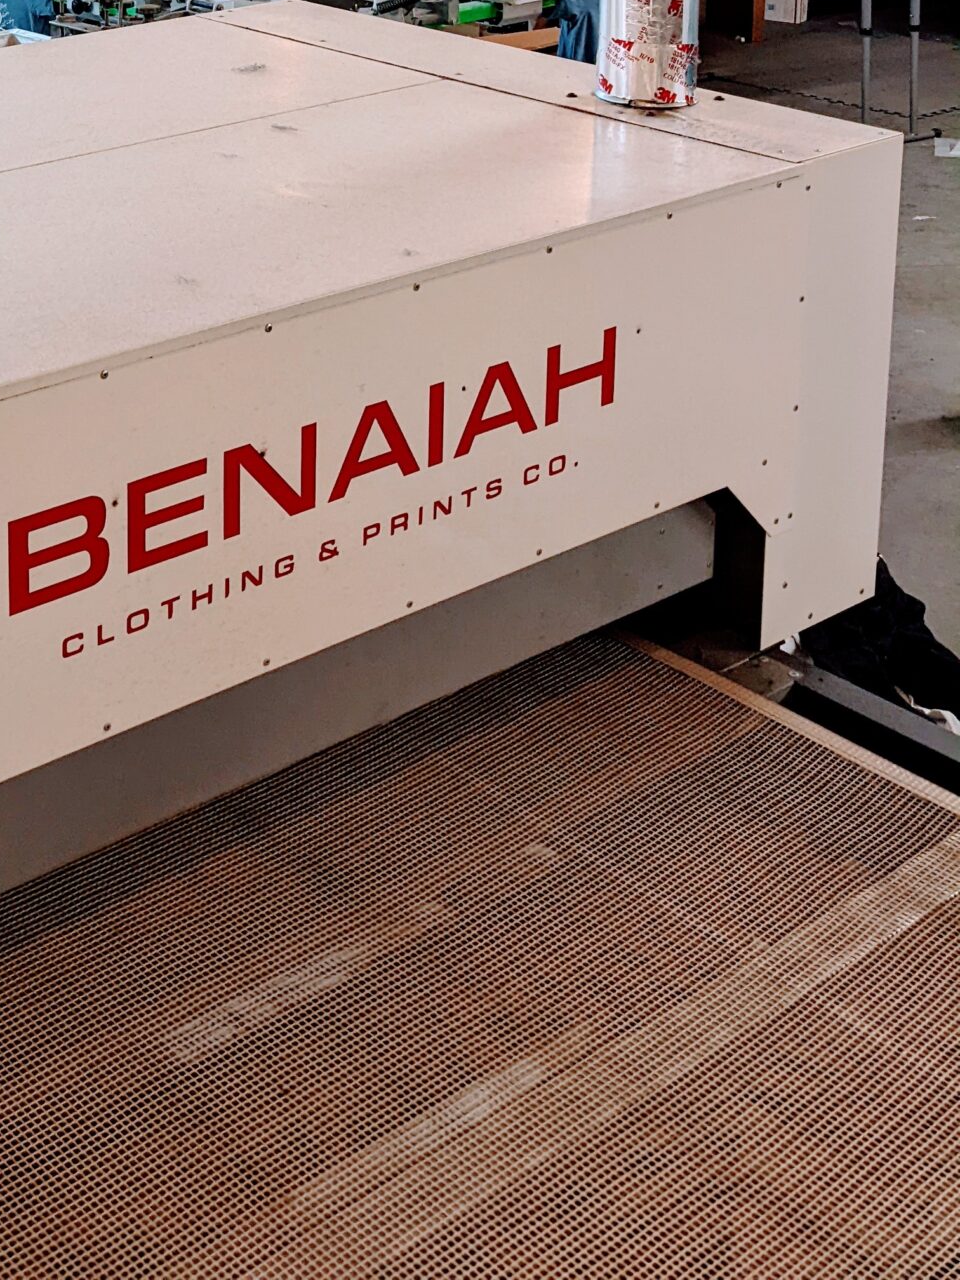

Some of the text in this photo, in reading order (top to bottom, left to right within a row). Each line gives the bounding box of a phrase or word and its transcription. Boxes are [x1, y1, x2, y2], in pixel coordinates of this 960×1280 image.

[654, 86, 678, 103] 3M
[7, 326, 617, 616] BENAIAH
[61, 455, 579, 659] CLOTHING & PRINTS CO.
